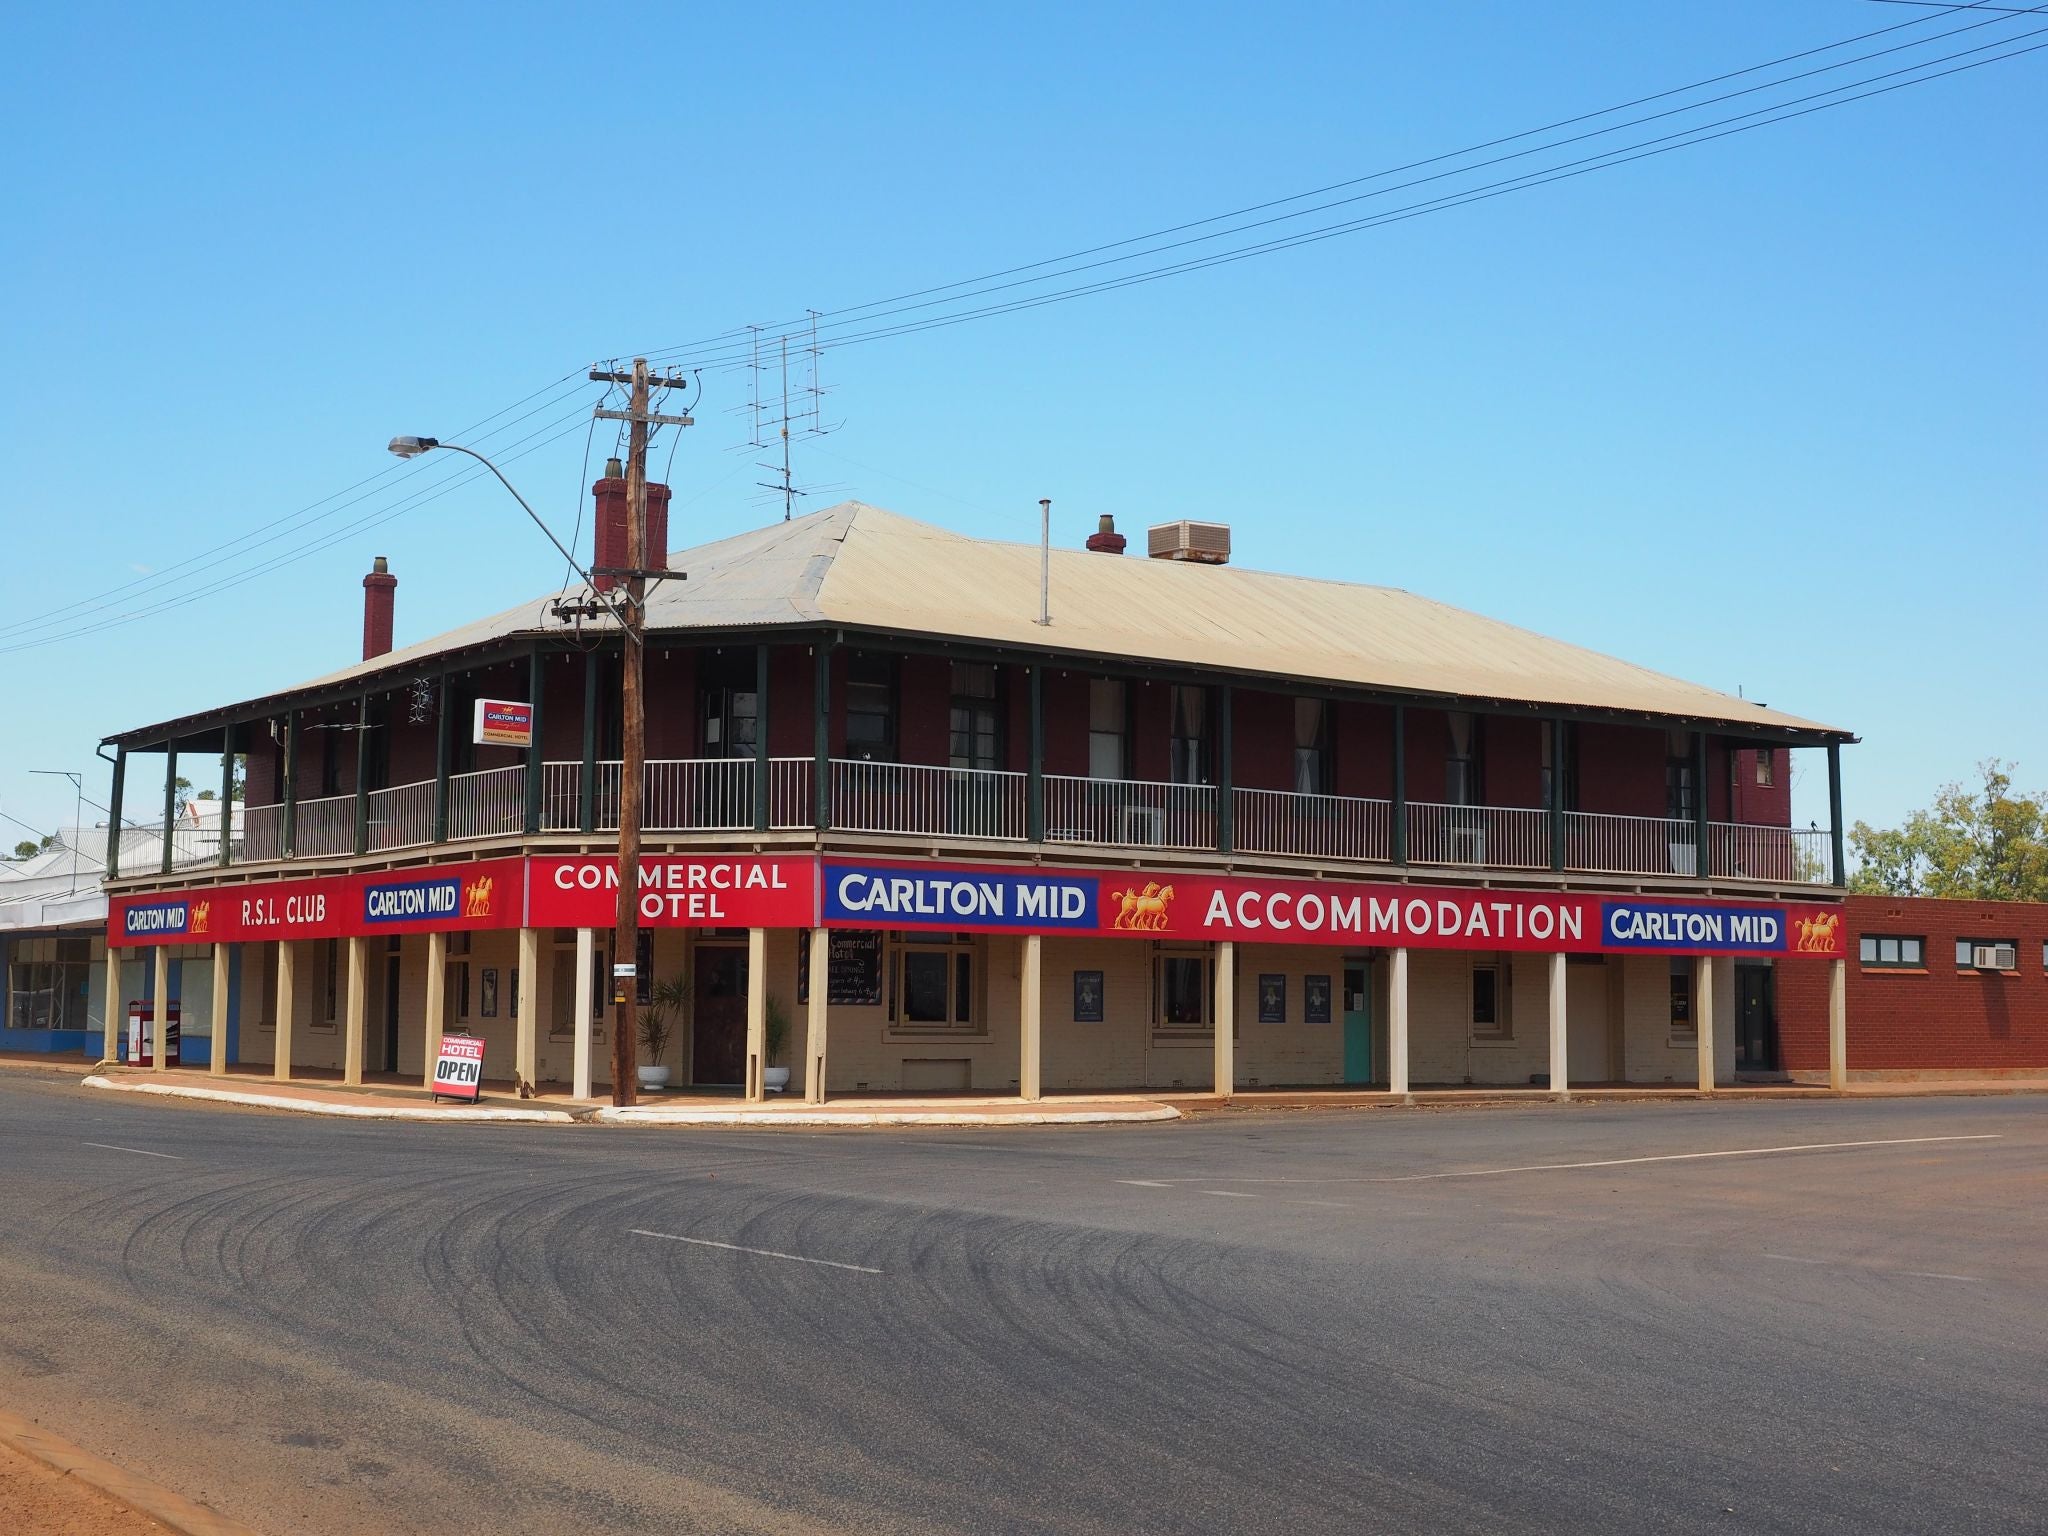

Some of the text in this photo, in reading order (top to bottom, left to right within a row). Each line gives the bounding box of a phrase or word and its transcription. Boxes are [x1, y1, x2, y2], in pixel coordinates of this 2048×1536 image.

[488, 713, 513, 721] CARLTON
[368, 885, 456, 916] CARLTON MID
[616, 893, 725, 918] OTEL
[838, 873, 1086, 919] CARLTON MID
[127, 907, 185, 931] CARLTON MID
[242, 894, 326, 926] R.S.L. CLUB
[1203, 889, 1583, 940] ACCOMMODATION
[1610, 908, 1778, 944] CARLTON MID
[441, 1044, 481, 1057] HOTEL
[443, 1037, 483, 1047] COMMERCIAL
[437, 1060, 479, 1082] OPEN
